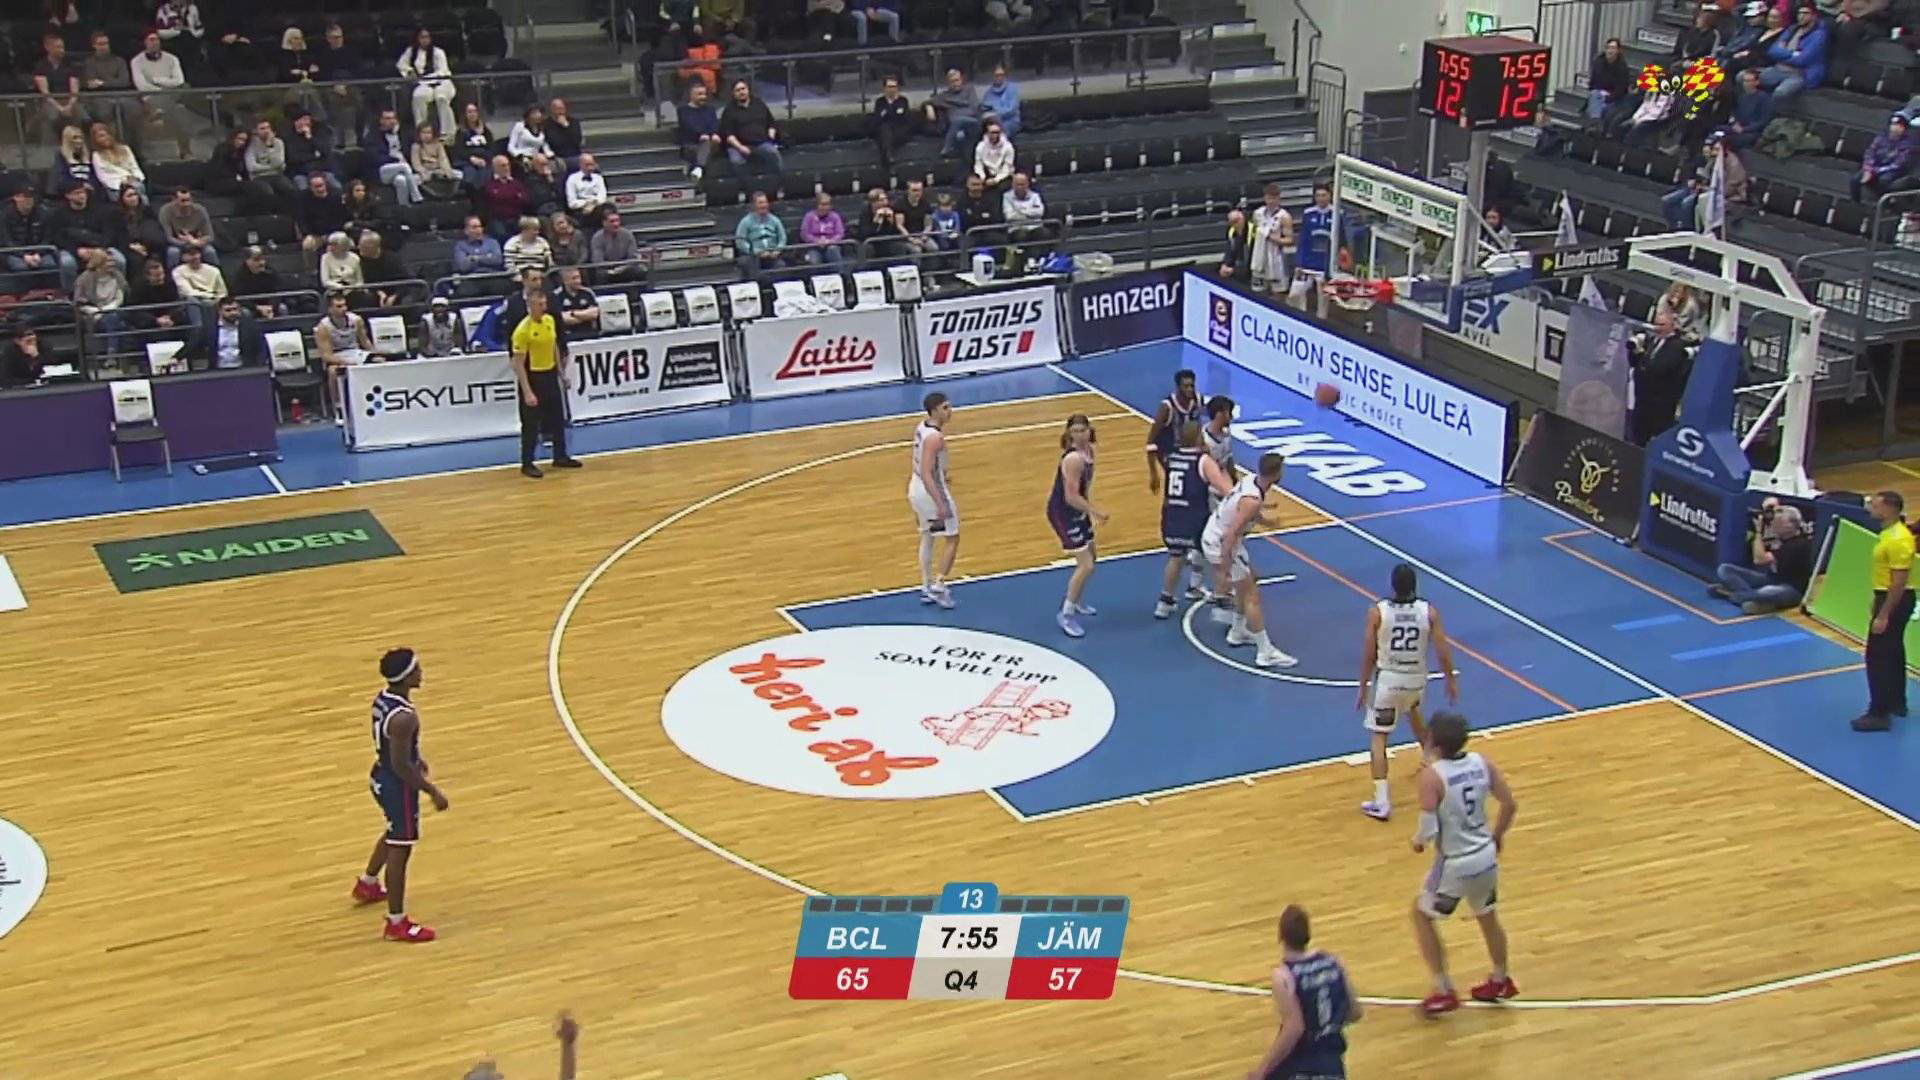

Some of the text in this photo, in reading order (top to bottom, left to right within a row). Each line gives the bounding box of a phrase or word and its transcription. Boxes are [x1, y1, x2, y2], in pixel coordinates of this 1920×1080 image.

[1437, 50, 1470, 81] 7:55
[1499, 53, 1546, 79] 7:55
[1437, 79, 1461, 117] 12
[1499, 84, 1536, 117] 12
[574, 347, 650, 396] JWAB
[775, 329, 877, 380] Laitis
[1241, 314, 1323, 368] CLARION
[1330, 351, 1397, 406] SENSE,
[1404, 383, 1473, 436] LULEÅ
[384, 381, 516, 412] SKYLITE
[1230, 418, 1427, 497] LKAB
[1660, 492, 1718, 534] Lindroths
[1391, 626, 1420, 651] 22
[875, 651, 1058, 685] SOM VILL UPP
[808, 738, 939, 787] ab
[1461, 785, 1476, 816] 5
